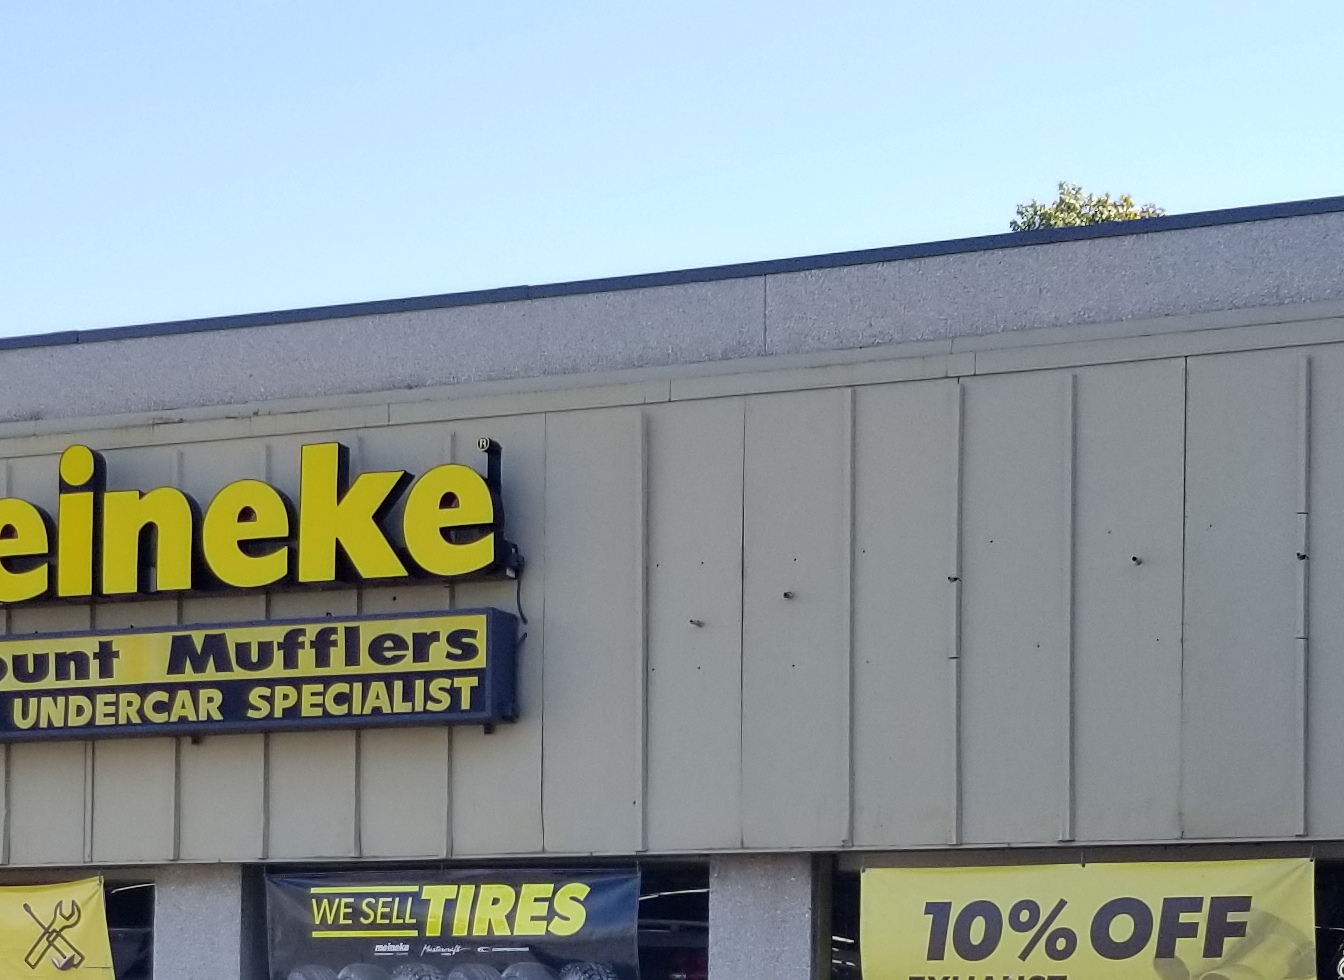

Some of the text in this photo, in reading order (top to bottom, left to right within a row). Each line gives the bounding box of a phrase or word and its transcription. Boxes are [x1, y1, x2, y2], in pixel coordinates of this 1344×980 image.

[167, 624, 481, 675] Mufflers
[13, 689, 223, 728] UNDERCAR
[246, 676, 480, 719] SPECIALIST
[310, 882, 591, 938] WE SELL TIRES
[922, 895, 1253, 963] 10% OFF
